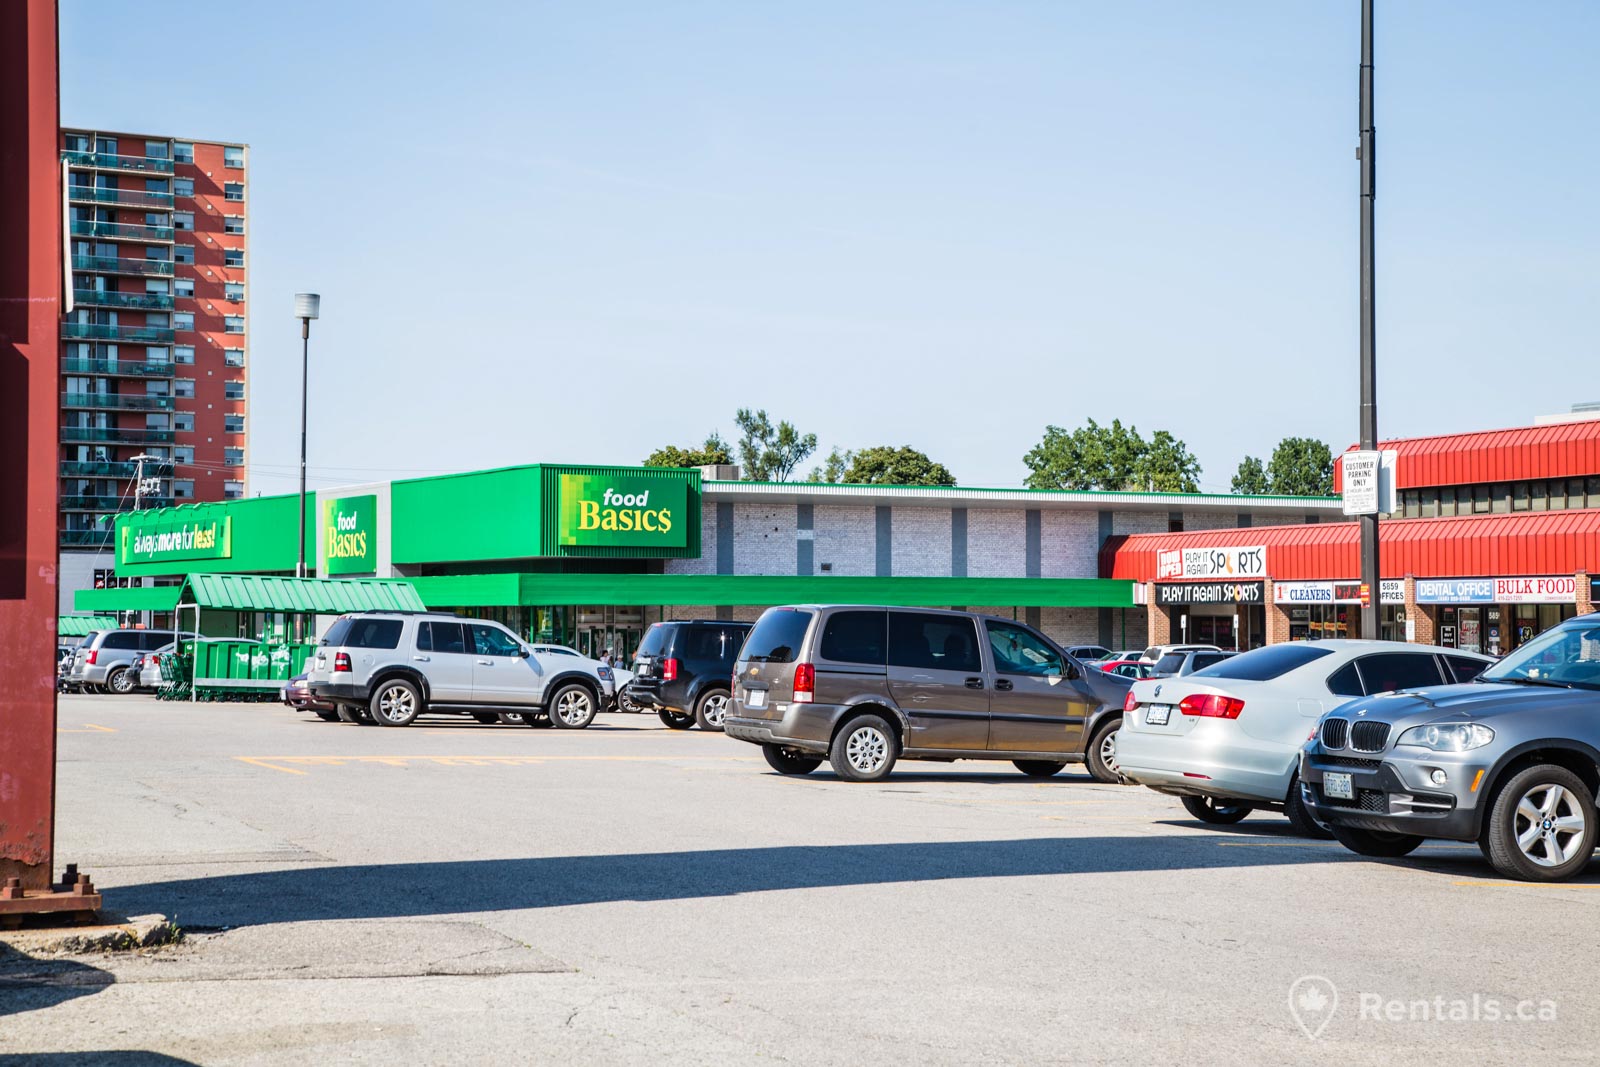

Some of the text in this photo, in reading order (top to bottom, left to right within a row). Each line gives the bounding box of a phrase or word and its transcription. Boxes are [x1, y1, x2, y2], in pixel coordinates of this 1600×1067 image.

[1346, 461, 1374, 470] CUSTOMER
[1348, 470, 1371, 478] PARKING
[1353, 479, 1366, 487] ONLY
[603, 487, 650, 507] food
[337, 510, 358, 531] food
[134, 528, 158, 558] always
[158, 531, 182, 551] more
[182, 523, 195, 550] for
[1185, 551, 1208, 563] PLAY IT
[1186, 563, 1208, 575] AGAIN
[1162, 582, 1259, 602] PLAY IT AGAIN SPORTS
[1382, 582, 1399, 590] 5859
[1420, 582, 1491, 596] DENTAL OFFICE
[1497, 578, 1575, 594] BULK FOOD
[1290, 589, 1331, 601] CLEANERS
[1380, 591, 1404, 600] FFICES
